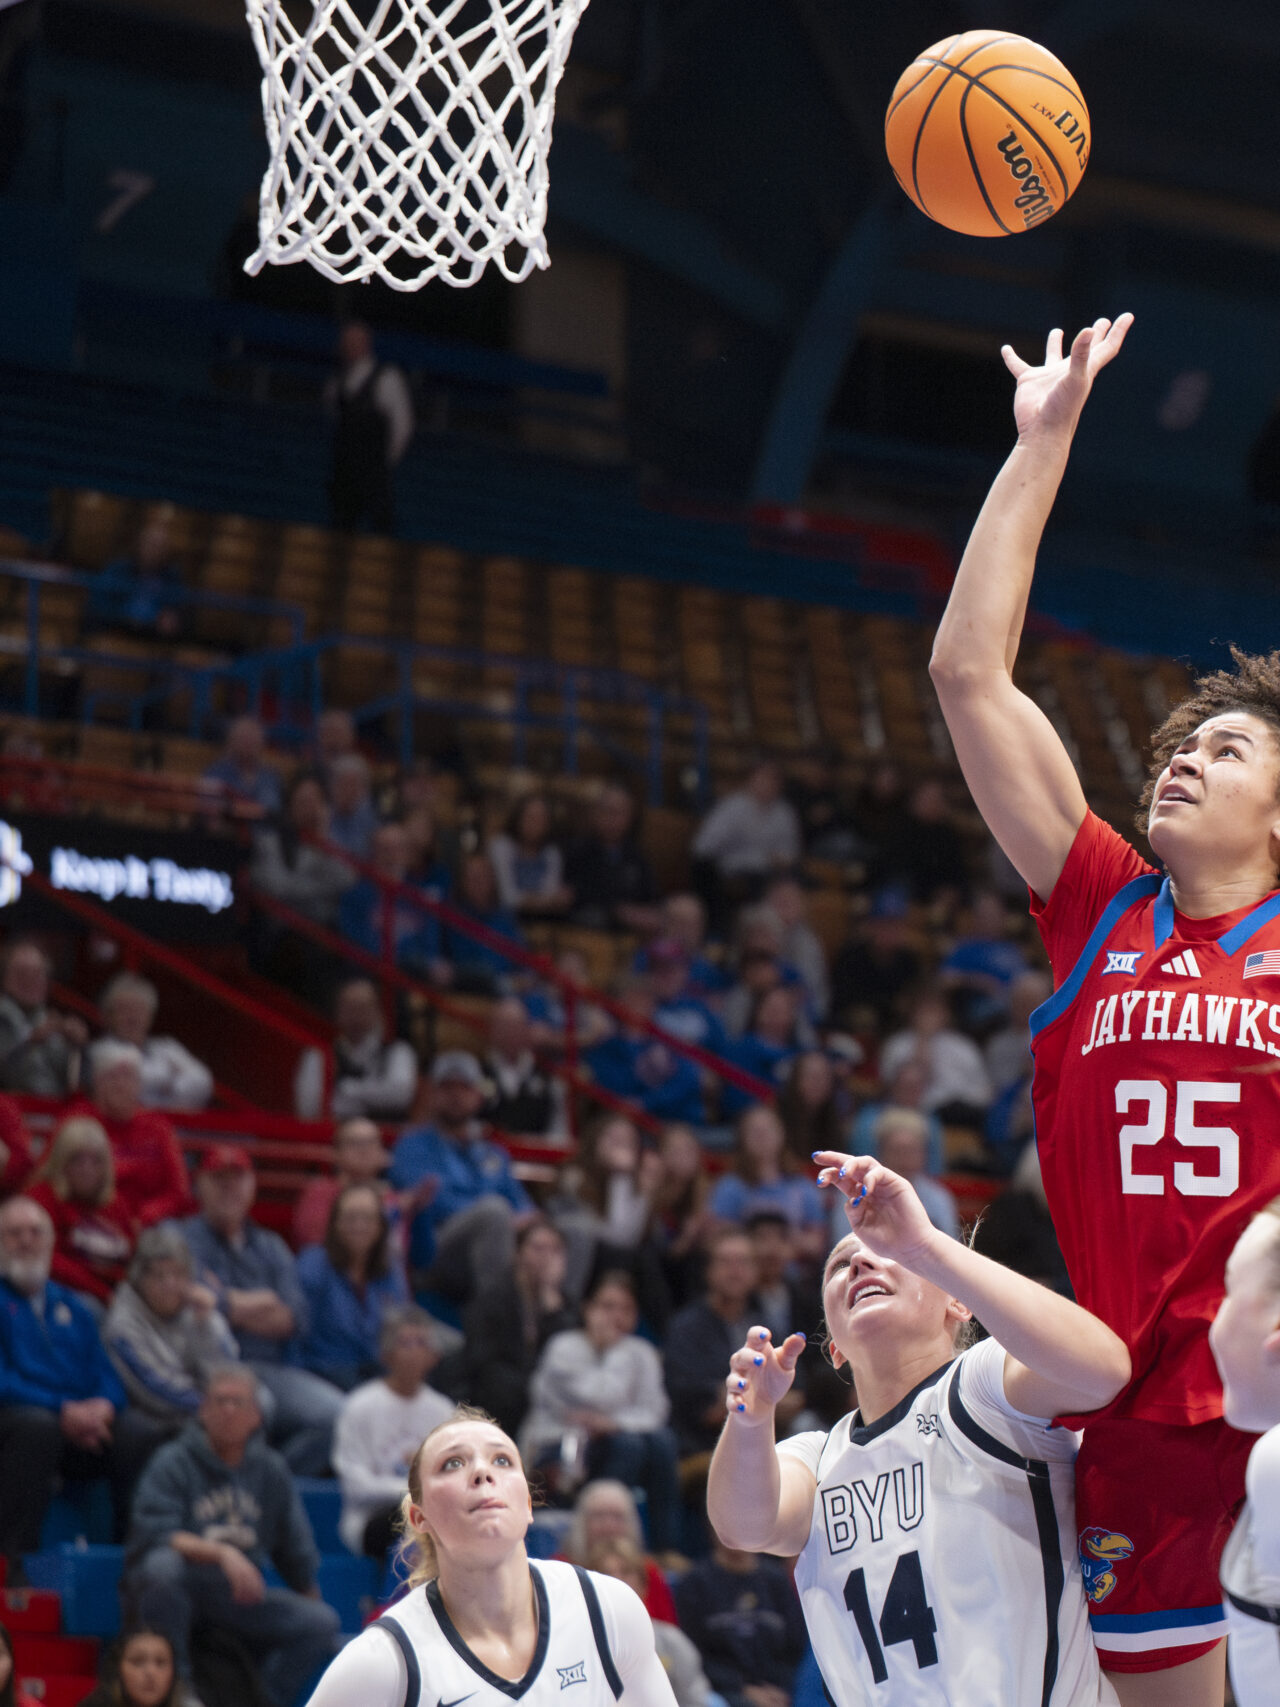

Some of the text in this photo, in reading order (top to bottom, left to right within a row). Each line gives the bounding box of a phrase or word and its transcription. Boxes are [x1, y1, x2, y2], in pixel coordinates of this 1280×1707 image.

[1031, 102, 1055, 121] NXT
[95, 169, 157, 233] 7
[1114, 1079, 1241, 1197] 25
[821, 1462, 924, 1556] BYU
[842, 1549, 939, 1685] 14
